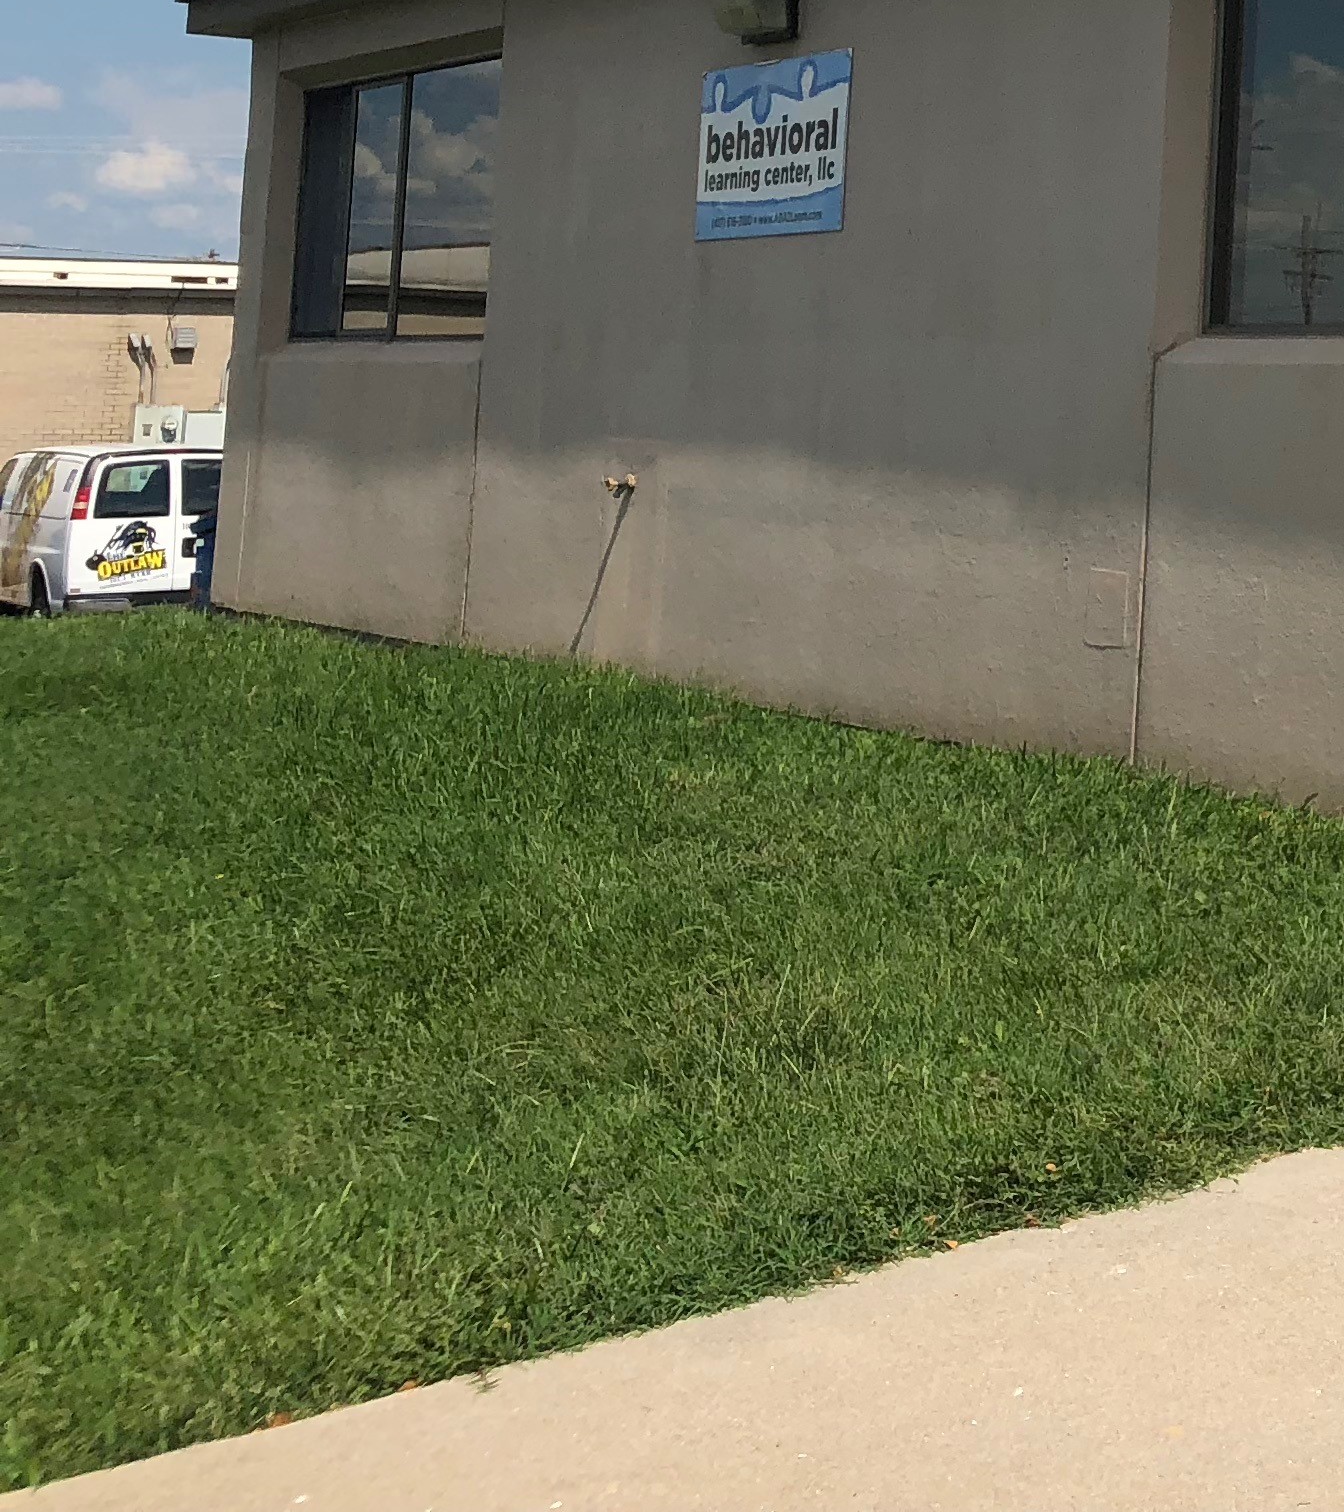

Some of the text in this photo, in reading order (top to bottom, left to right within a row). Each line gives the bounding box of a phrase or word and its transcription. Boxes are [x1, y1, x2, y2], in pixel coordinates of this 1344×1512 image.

[706, 107, 838, 164] behavioral
[704, 156, 835, 192] learning center, llc
[98, 550, 164, 578] OUTLAW
